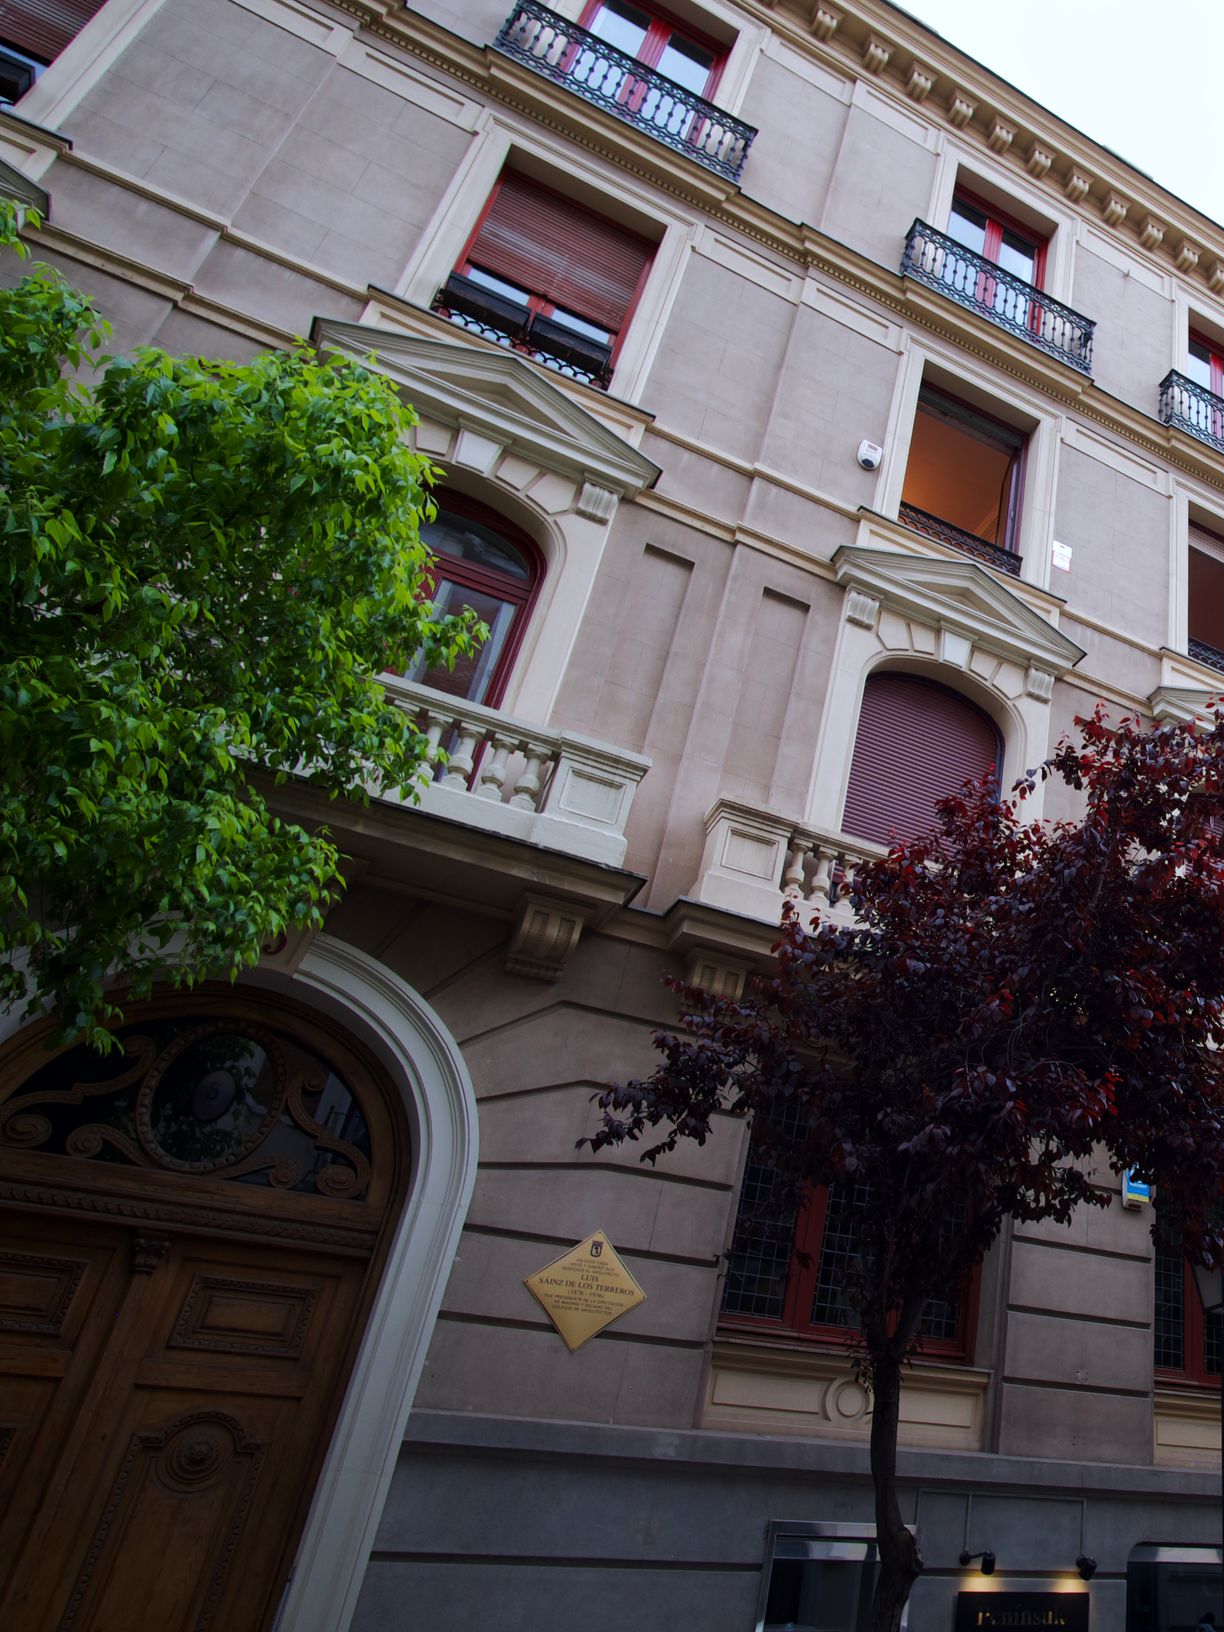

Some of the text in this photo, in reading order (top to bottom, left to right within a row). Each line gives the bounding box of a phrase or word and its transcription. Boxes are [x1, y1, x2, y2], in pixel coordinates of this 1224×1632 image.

[580, 1274, 600, 1282] LUIS
[578, 1282, 593, 1290] LOS
[596, 1284, 635, 1296] TERREROS
